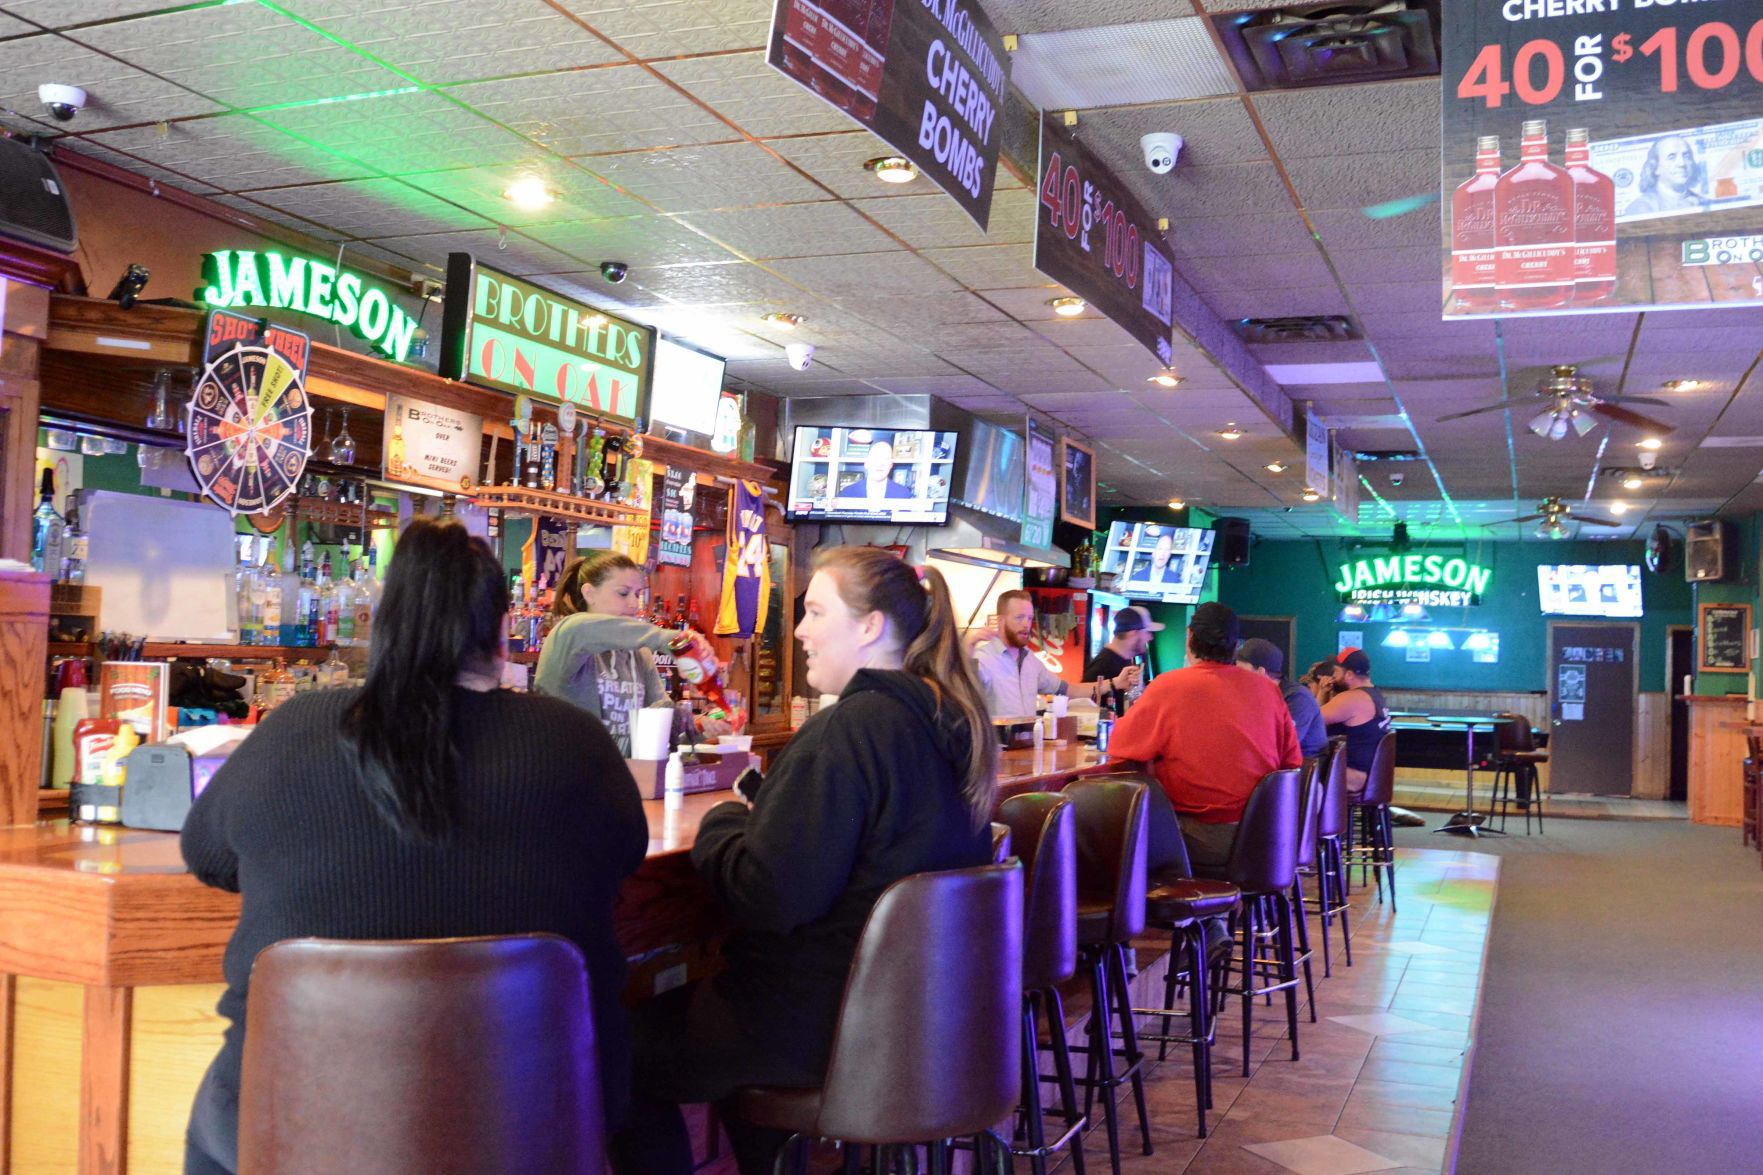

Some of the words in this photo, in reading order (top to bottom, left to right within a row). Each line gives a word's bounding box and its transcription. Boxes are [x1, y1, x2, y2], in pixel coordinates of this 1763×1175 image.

[927, 39, 995, 146] CHERRY
[1457, 39, 1565, 108] 40
[1574, 33, 1602, 101] FOR
[918, 99, 985, 199] BOMBS
[1041, 151, 1081, 239] 40
[1081, 180, 1094, 252] FOR
[205, 249, 418, 363] JAMESON
[209, 313, 259, 347] SHOT
[474, 272, 642, 369] BROTHERS
[481, 337, 537, 392] ON
[555, 362, 630, 418] OAK
[1334, 554, 1493, 596] JAMESON
[609, 710, 625, 723] ON
